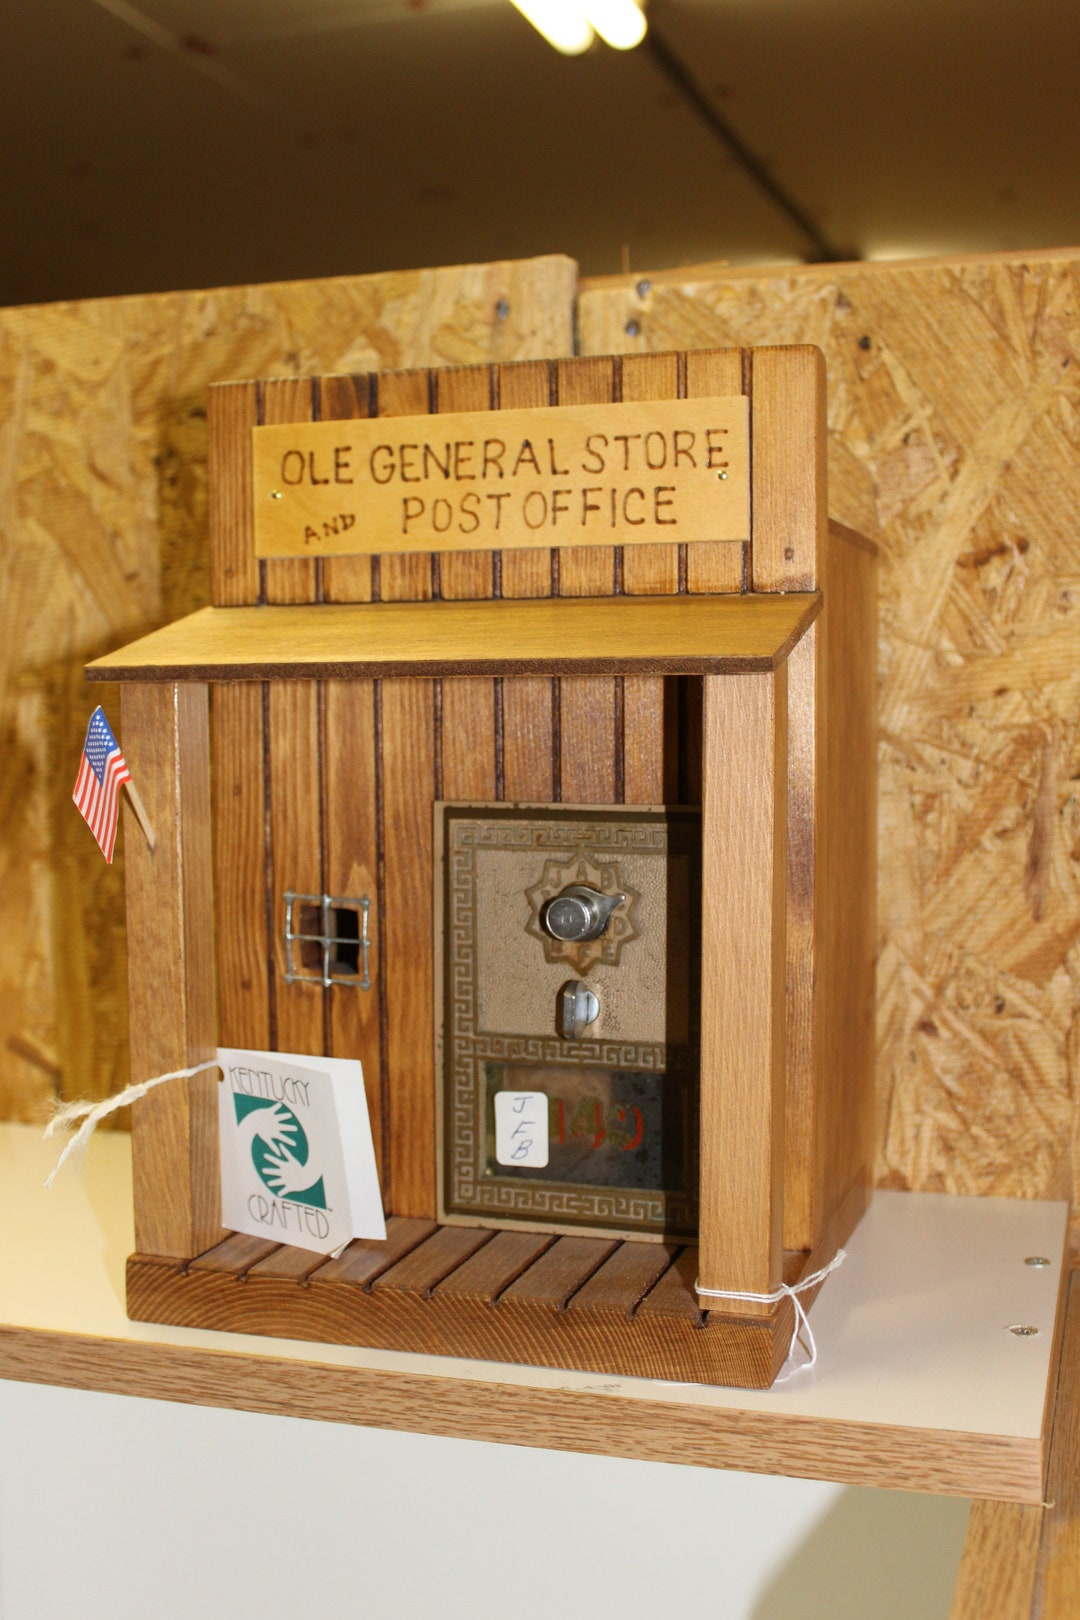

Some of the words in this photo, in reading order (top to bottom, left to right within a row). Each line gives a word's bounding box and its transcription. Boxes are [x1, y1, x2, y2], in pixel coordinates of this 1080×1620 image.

[280, 446, 354, 486] OLE
[369, 438, 569, 484] GENERAL
[580, 429, 729, 474] STORE
[303, 513, 357, 545] AND
[402, 492, 511, 535] POST
[521, 486, 678, 530] OFFICE
[228, 1066, 310, 1107] KENTUCKY
[248, 1194, 330, 1239] CRAFTED
